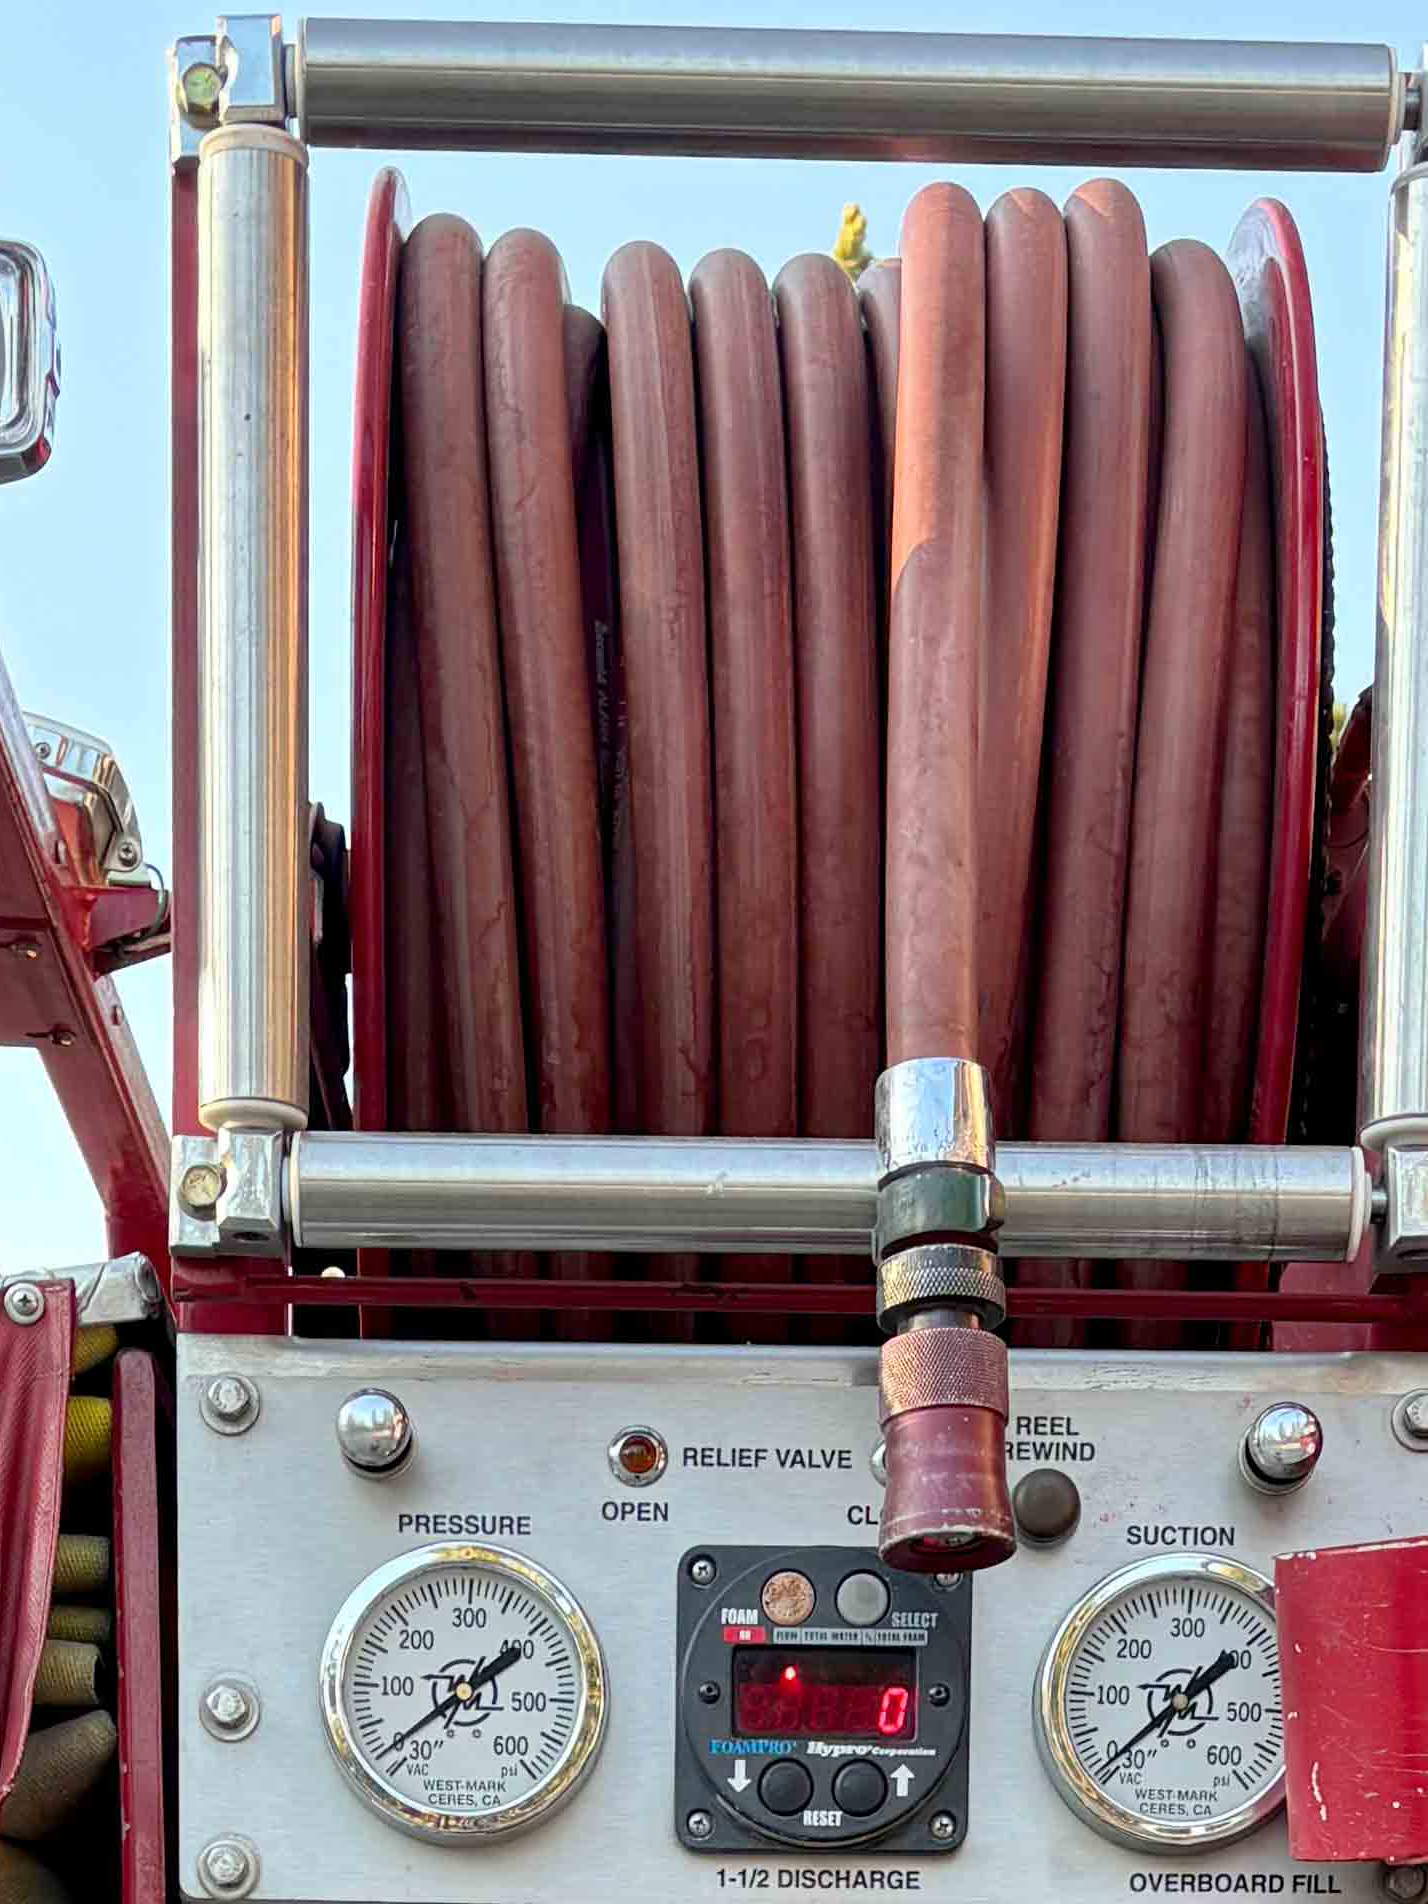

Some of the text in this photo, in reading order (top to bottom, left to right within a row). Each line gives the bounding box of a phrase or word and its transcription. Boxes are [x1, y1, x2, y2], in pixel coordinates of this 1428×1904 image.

[1016, 1416, 1079, 1436] REEL
[682, 1449, 853, 1469] RELIEF VALVE
[602, 1502, 669, 1522] OPEN
[398, 1514, 532, 1536] PRESSURE
[1127, 1525, 1236, 1546] SUCTION
[452, 1608, 487, 1628] 300
[721, 1608, 759, 1625] FOAM
[892, 1612, 938, 1628] SELECT
[1171, 1618, 1205, 1638] 300
[399, 1630, 434, 1650] 200
[1117, 1640, 1152, 1660] 200
[381, 1677, 414, 1696] 100
[1097, 1686, 1130, 1705] 100
[511, 1692, 547, 1712] 500
[879, 1687, 909, 1734] 0
[1227, 1702, 1262, 1722] 500
[493, 1736, 529, 1756] 600
[1206, 1746, 1242, 1766] 600
[407, 1764, 429, 1777] VAC
[501, 1763, 518, 1778] psi
[1118, 1773, 1141, 1785] VAC
[423, 1779, 506, 1793] WEST-MARK
[1213, 1774, 1231, 1788] psi
[481, 1794, 501, 1807] CA
[1135, 1788, 1218, 1801] WEST-MARK
[803, 1810, 843, 1827] RESET
[1193, 1803, 1213, 1816] CA
[717, 1869, 922, 1890] 1-1/2 DISCHARGE
[1129, 1873, 1342, 1894] OVERBOARD FILL
